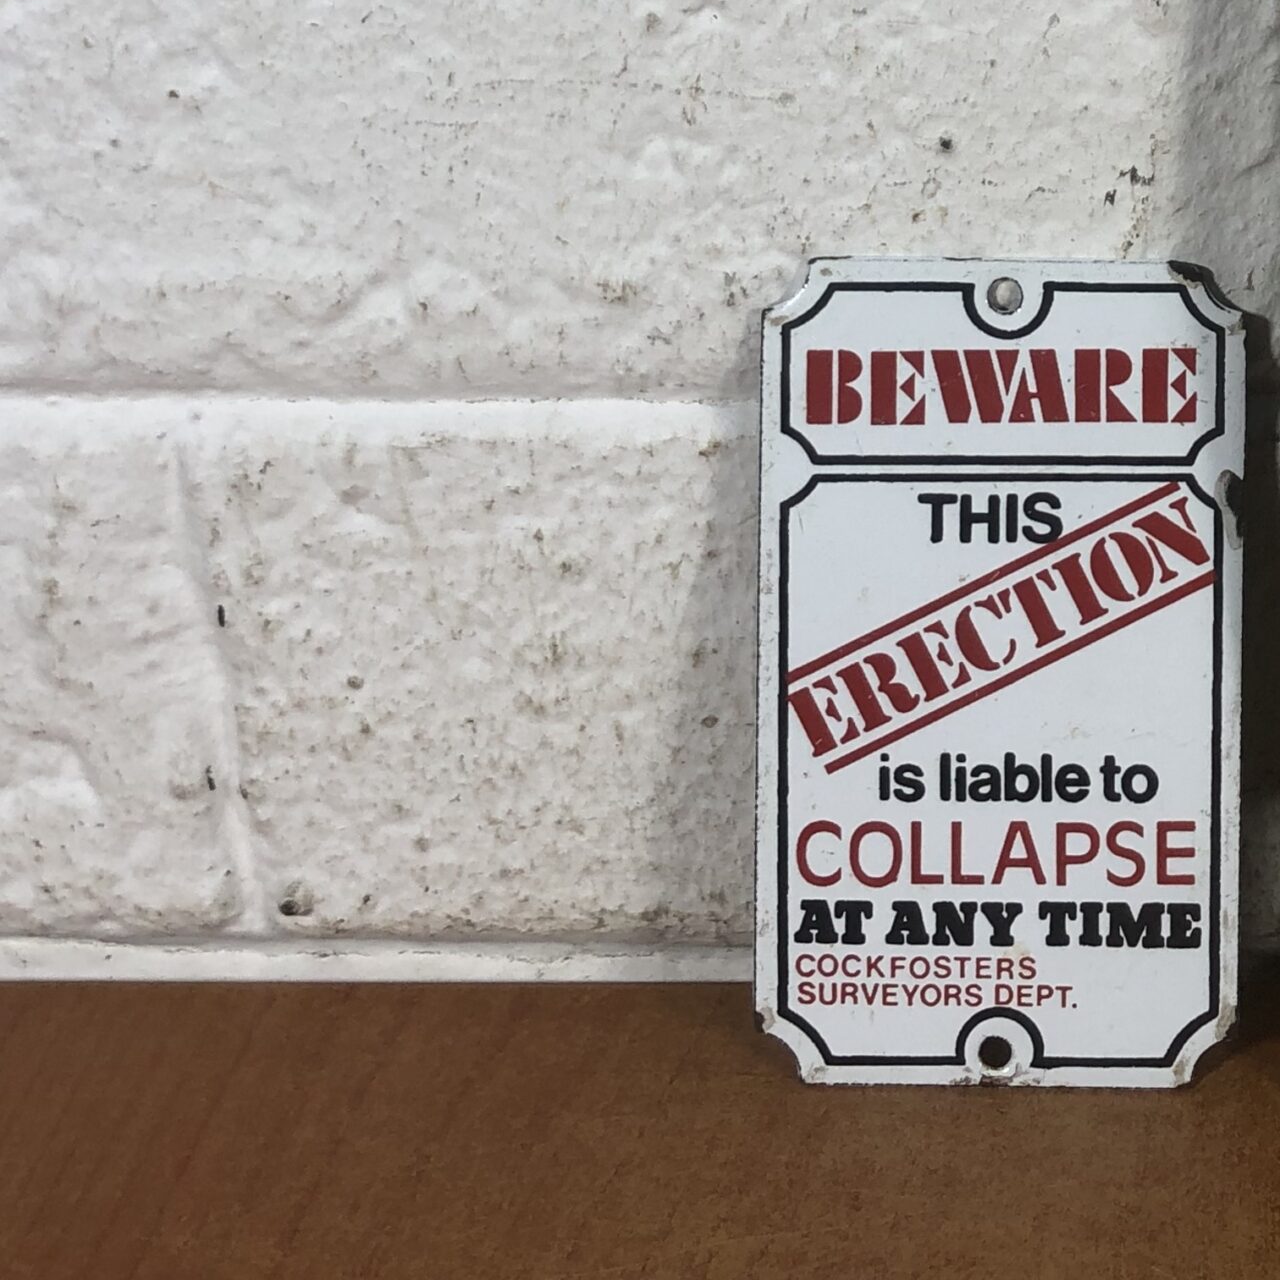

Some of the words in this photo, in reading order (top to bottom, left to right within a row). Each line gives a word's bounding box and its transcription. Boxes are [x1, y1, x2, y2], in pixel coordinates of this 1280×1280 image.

[806, 348, 1197, 425] BEWARE
[917, 492, 1063, 544] THIS
[787, 497, 1211, 758] ERECTION
[879, 753, 926, 802] is
[939, 752, 1091, 802] liable
[1100, 755, 1159, 803] to
[796, 820, 1196, 887] COLLAPSE
[794, 899, 873, 944] AT
[885, 900, 1023, 947] ANY
[1039, 902, 1202, 949] TIME
[794, 953, 1037, 980] COCKFOSTERS
[797, 982, 983, 1007] SURVEYORS
[993, 984, 1078, 1009] DEPT.
